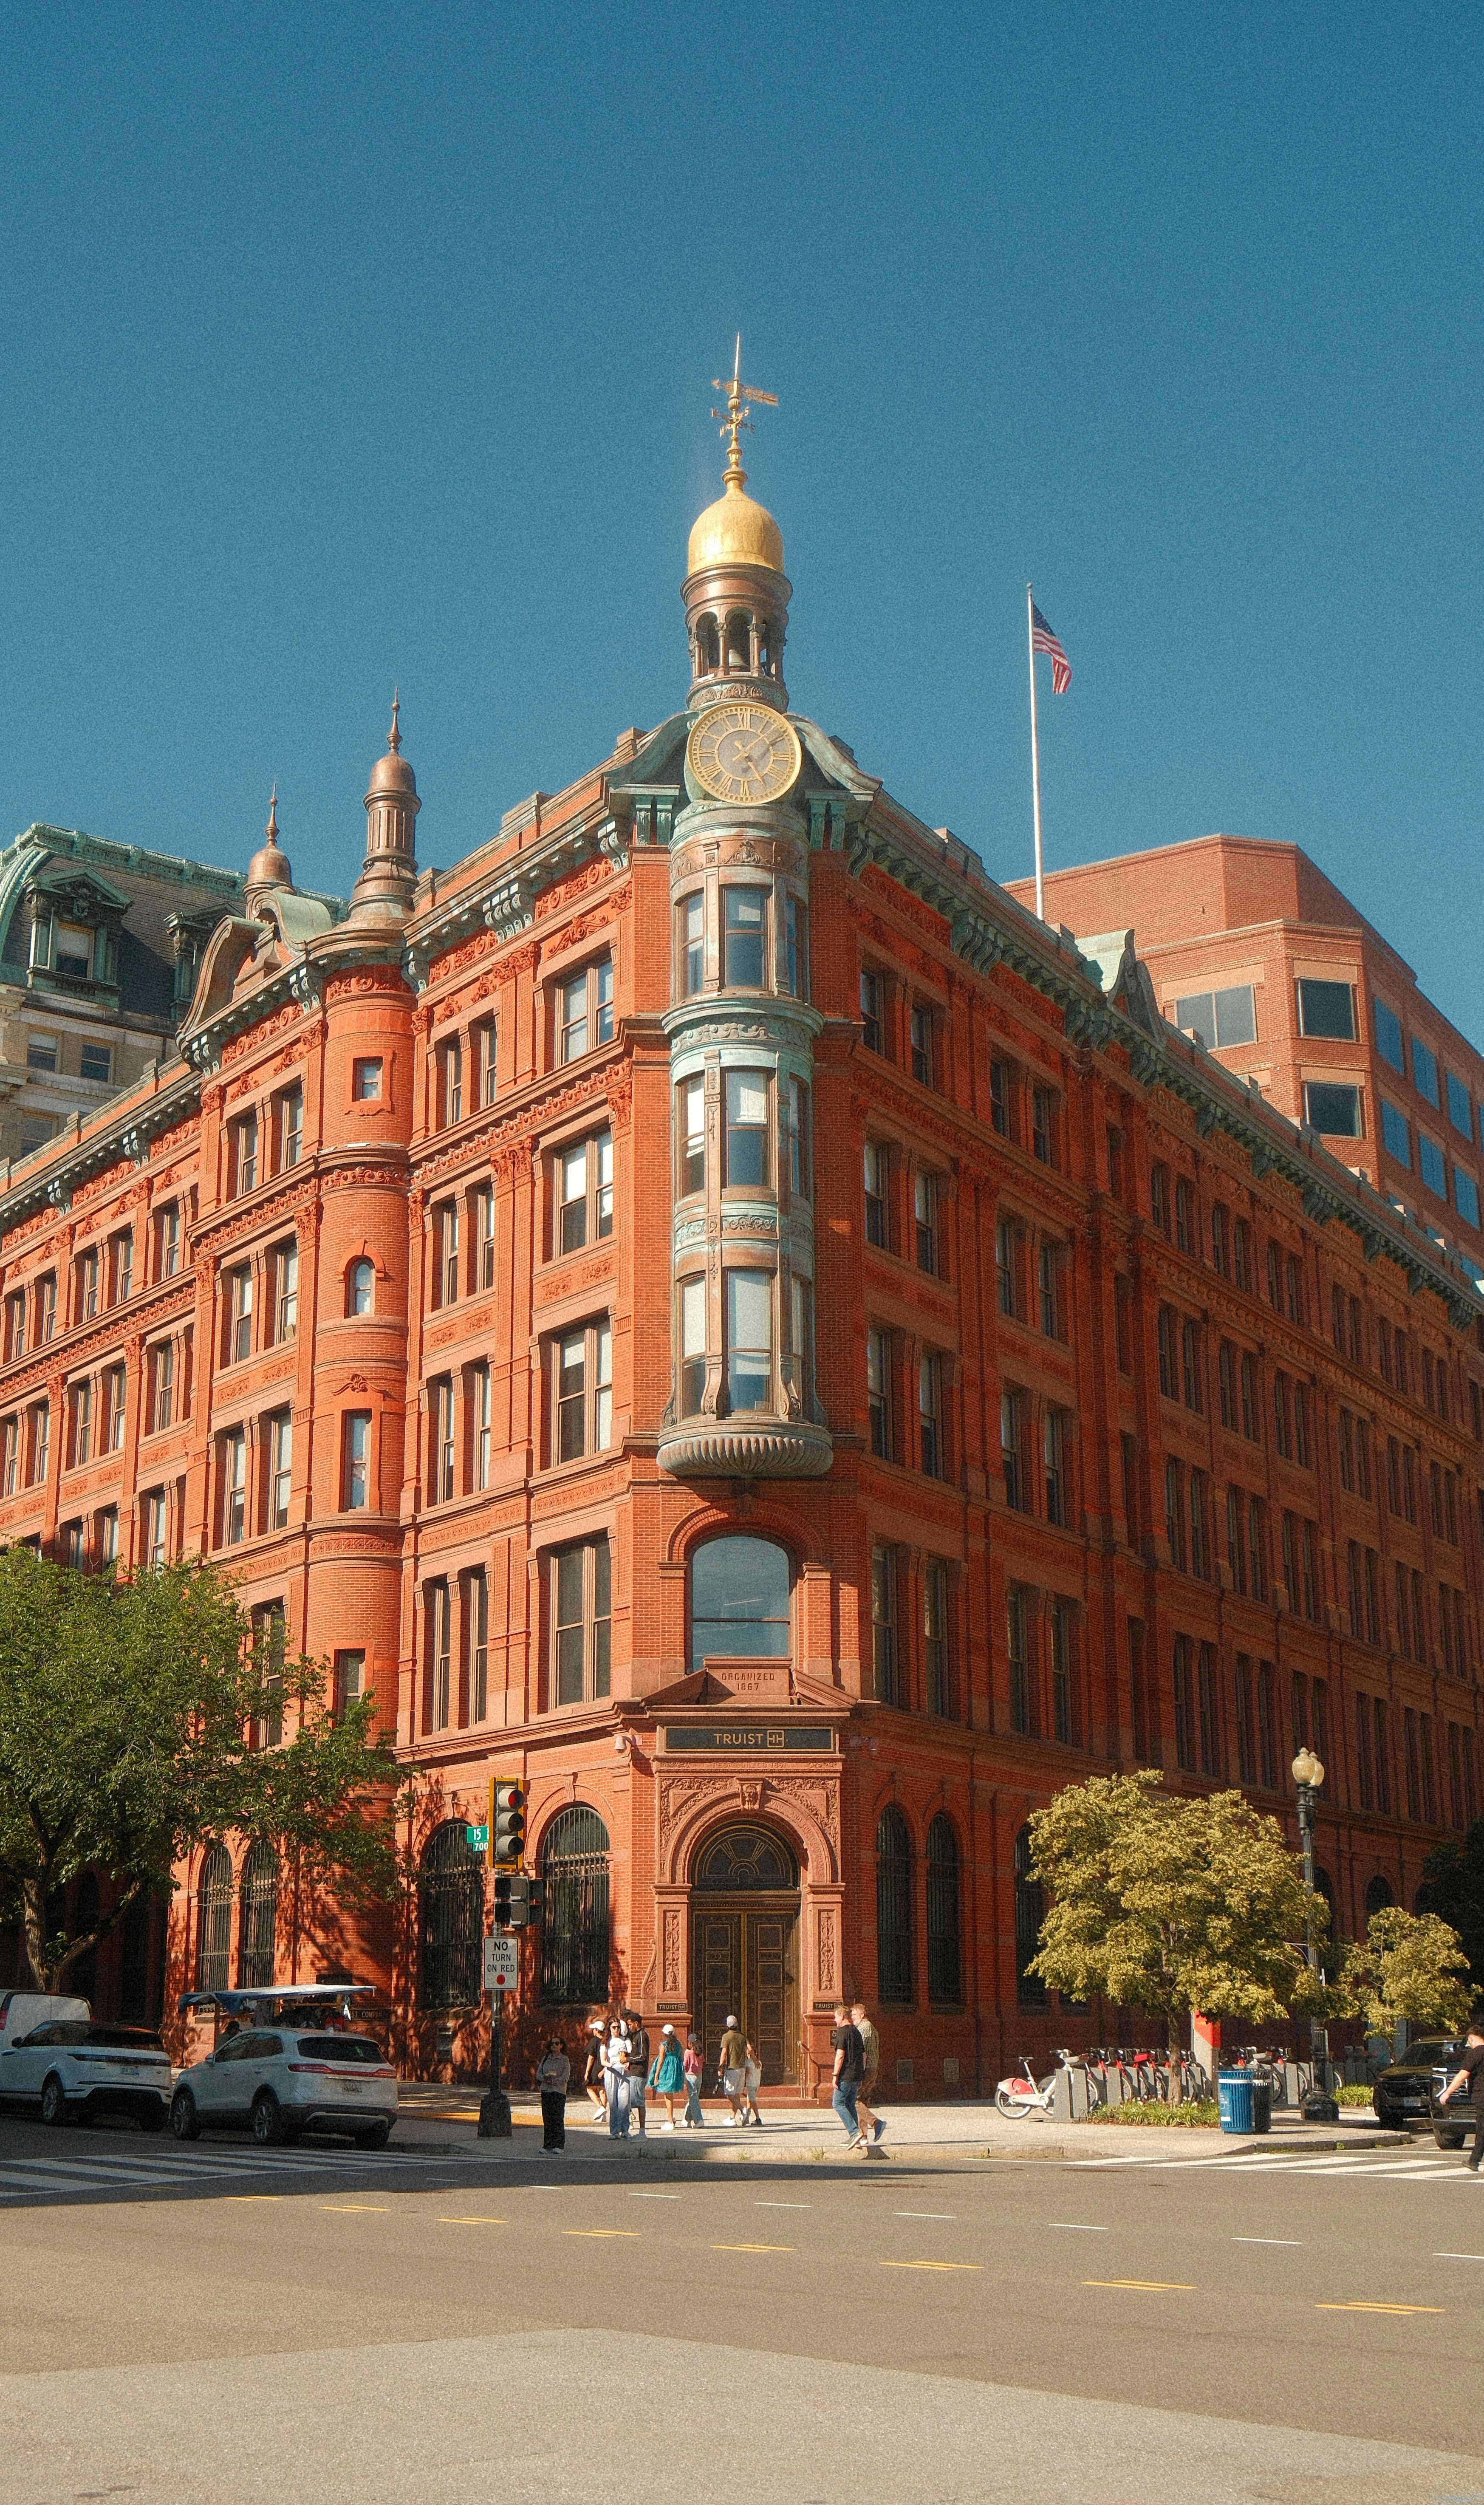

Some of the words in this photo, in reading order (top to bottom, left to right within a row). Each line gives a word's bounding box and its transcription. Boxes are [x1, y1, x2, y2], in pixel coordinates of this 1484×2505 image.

[738, 713, 751, 729] XII
[721, 1673, 775, 1681] ORGANIZED
[714, 1733, 764, 1744] TRUIST
[473, 1828, 481, 1840] 15
[475, 1842, 489, 1851] 700
[494, 1941, 508, 1951] NO
[487, 1964, 497, 1972] ON
[500, 1964, 515, 1972] RED
